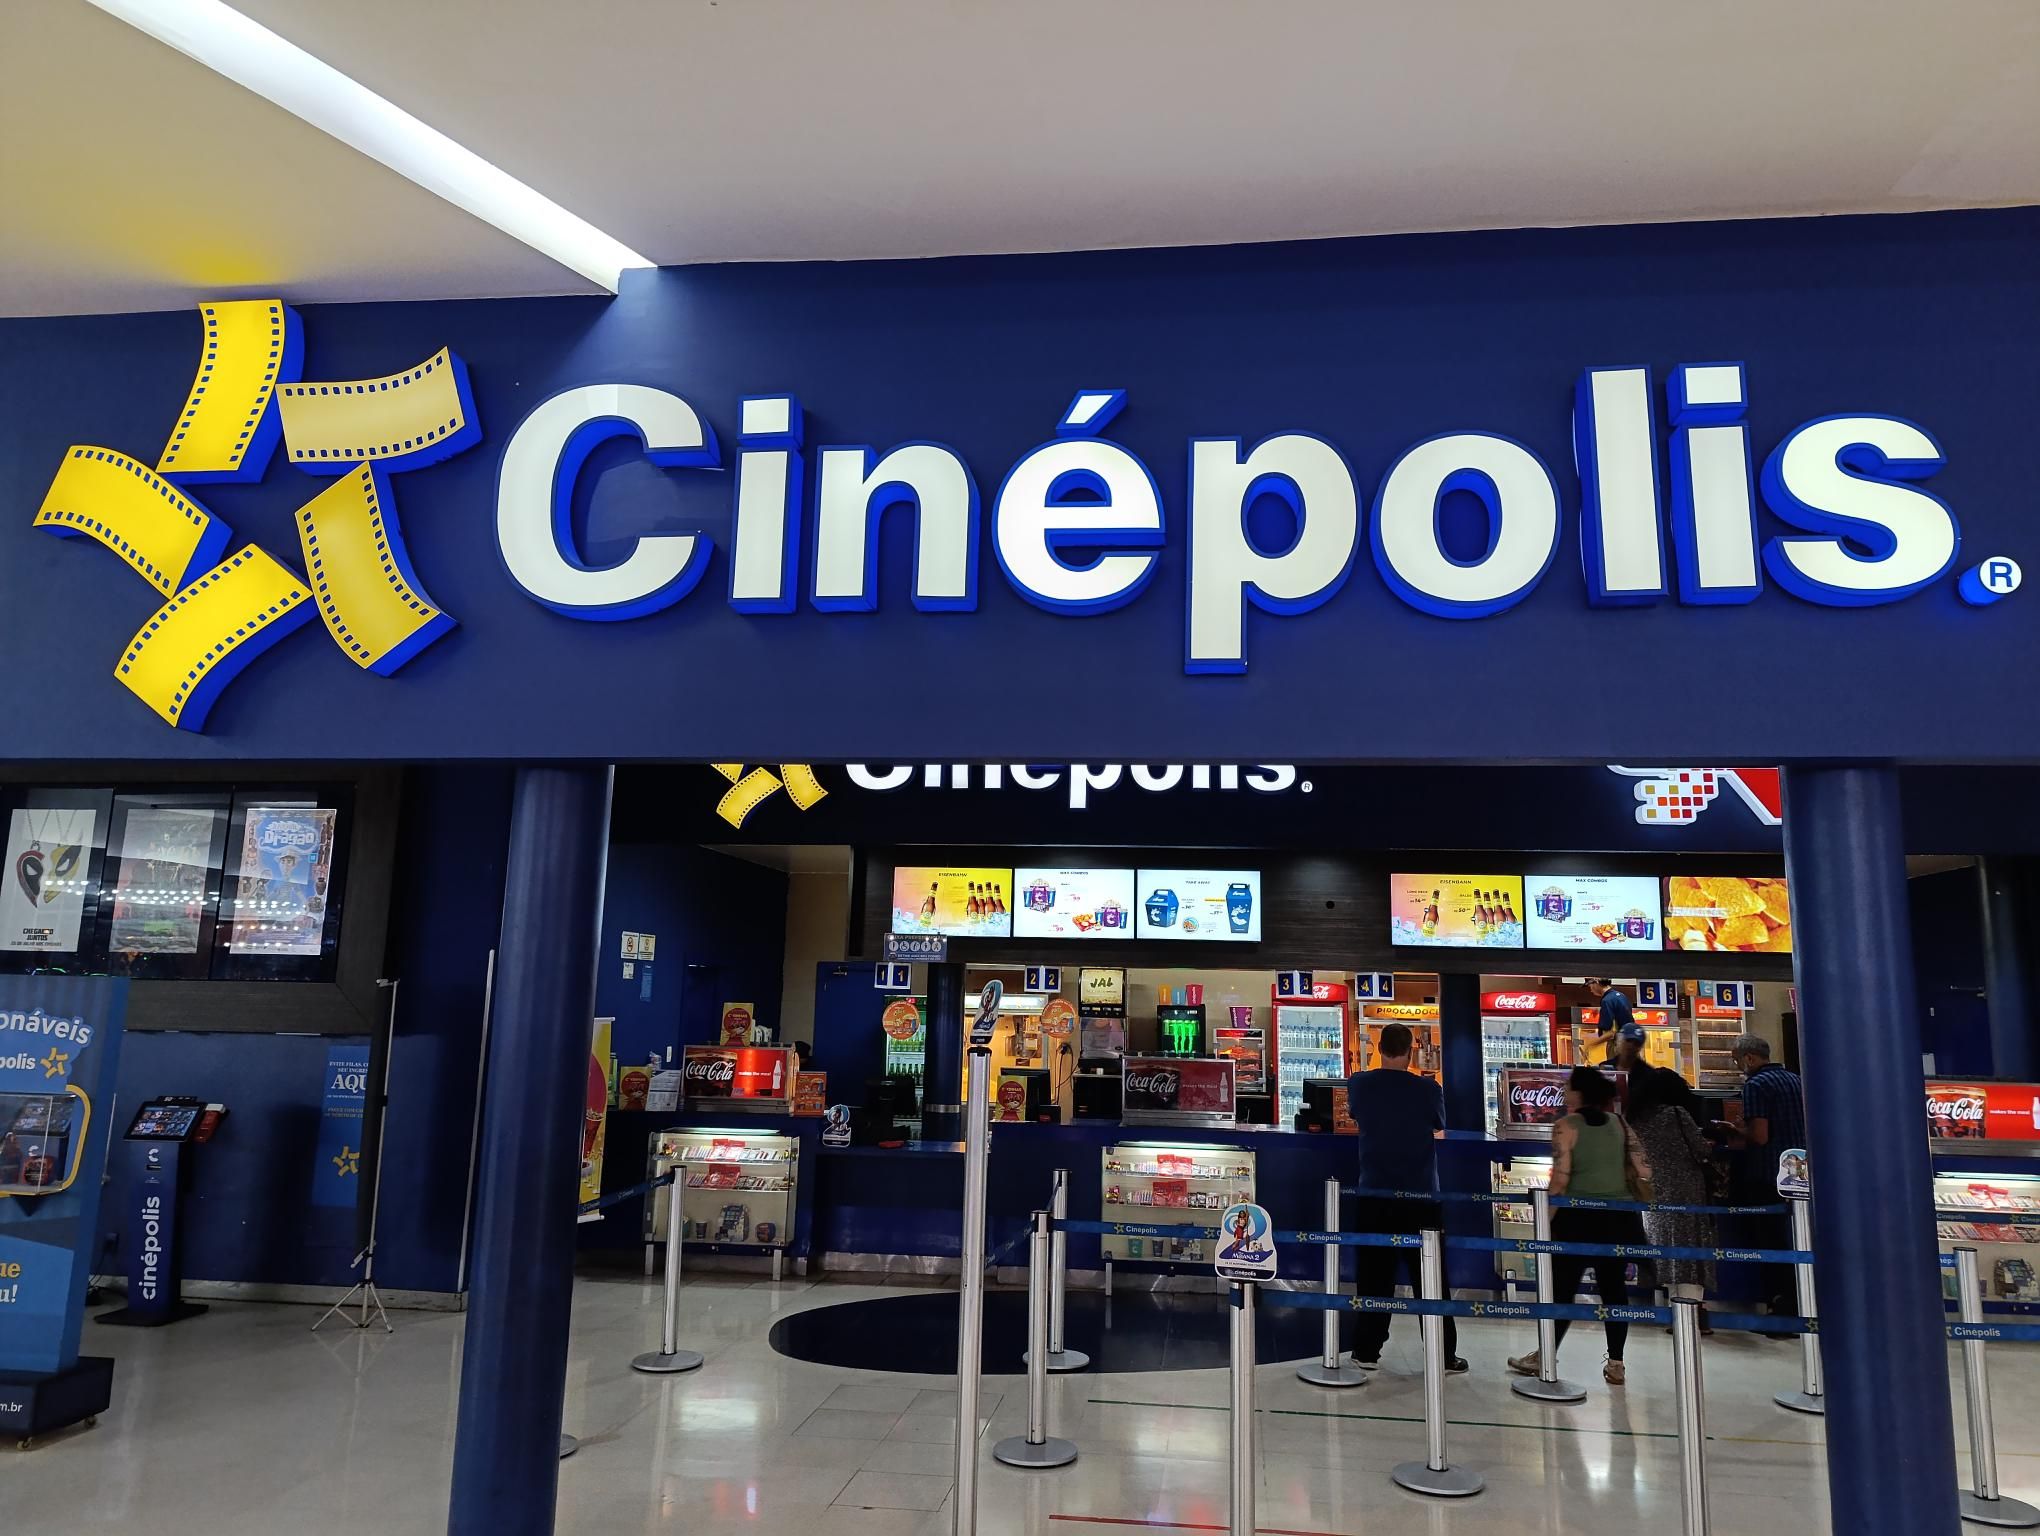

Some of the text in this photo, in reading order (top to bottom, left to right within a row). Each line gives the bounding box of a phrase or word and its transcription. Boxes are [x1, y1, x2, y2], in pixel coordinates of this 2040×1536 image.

[495, 364, 1957, 662] Cinépolis
[880, 969, 886, 982] 1
[897, 969, 904, 982] 1
[1029, 972, 1037, 986] 2
[1048, 973, 1056, 986] 2
[1282, 977, 1290, 991] 3
[1303, 977, 1309, 990] 3
[1360, 979, 1370, 992] 4
[1382, 980, 1389, 993] 4
[1646, 986, 1655, 1000] 5
[1668, 987, 1674, 1000] 5
[1722, 988, 1732, 1002] 6
[1494, 994, 1538, 1009] Coca-Cola
[1376, 1007, 1412, 1015] PIPOCA
[686, 1060, 736, 1081] Coca-Cola
[1125, 1072, 1178, 1093] Coca-Cola
[1926, 1097, 1985, 1120] Coca-Cola
[1308, 1233, 1342, 1243] Cinépolis
[138, 1196, 162, 1301] cinépolis
[1528, 1242, 1562, 1252] Cinépolis
[1626, 1246, 1662, 1257] Cinépolis
[1726, 1250, 1762, 1260] Cinépolis
[1364, 1299, 1408, 1312] Cinépolis
[1486, 1304, 1530, 1317] Cinépolis
[1611, 1308, 1656, 1321] Cinépolis
[1954, 1326, 2001, 1338] Cinépolis
